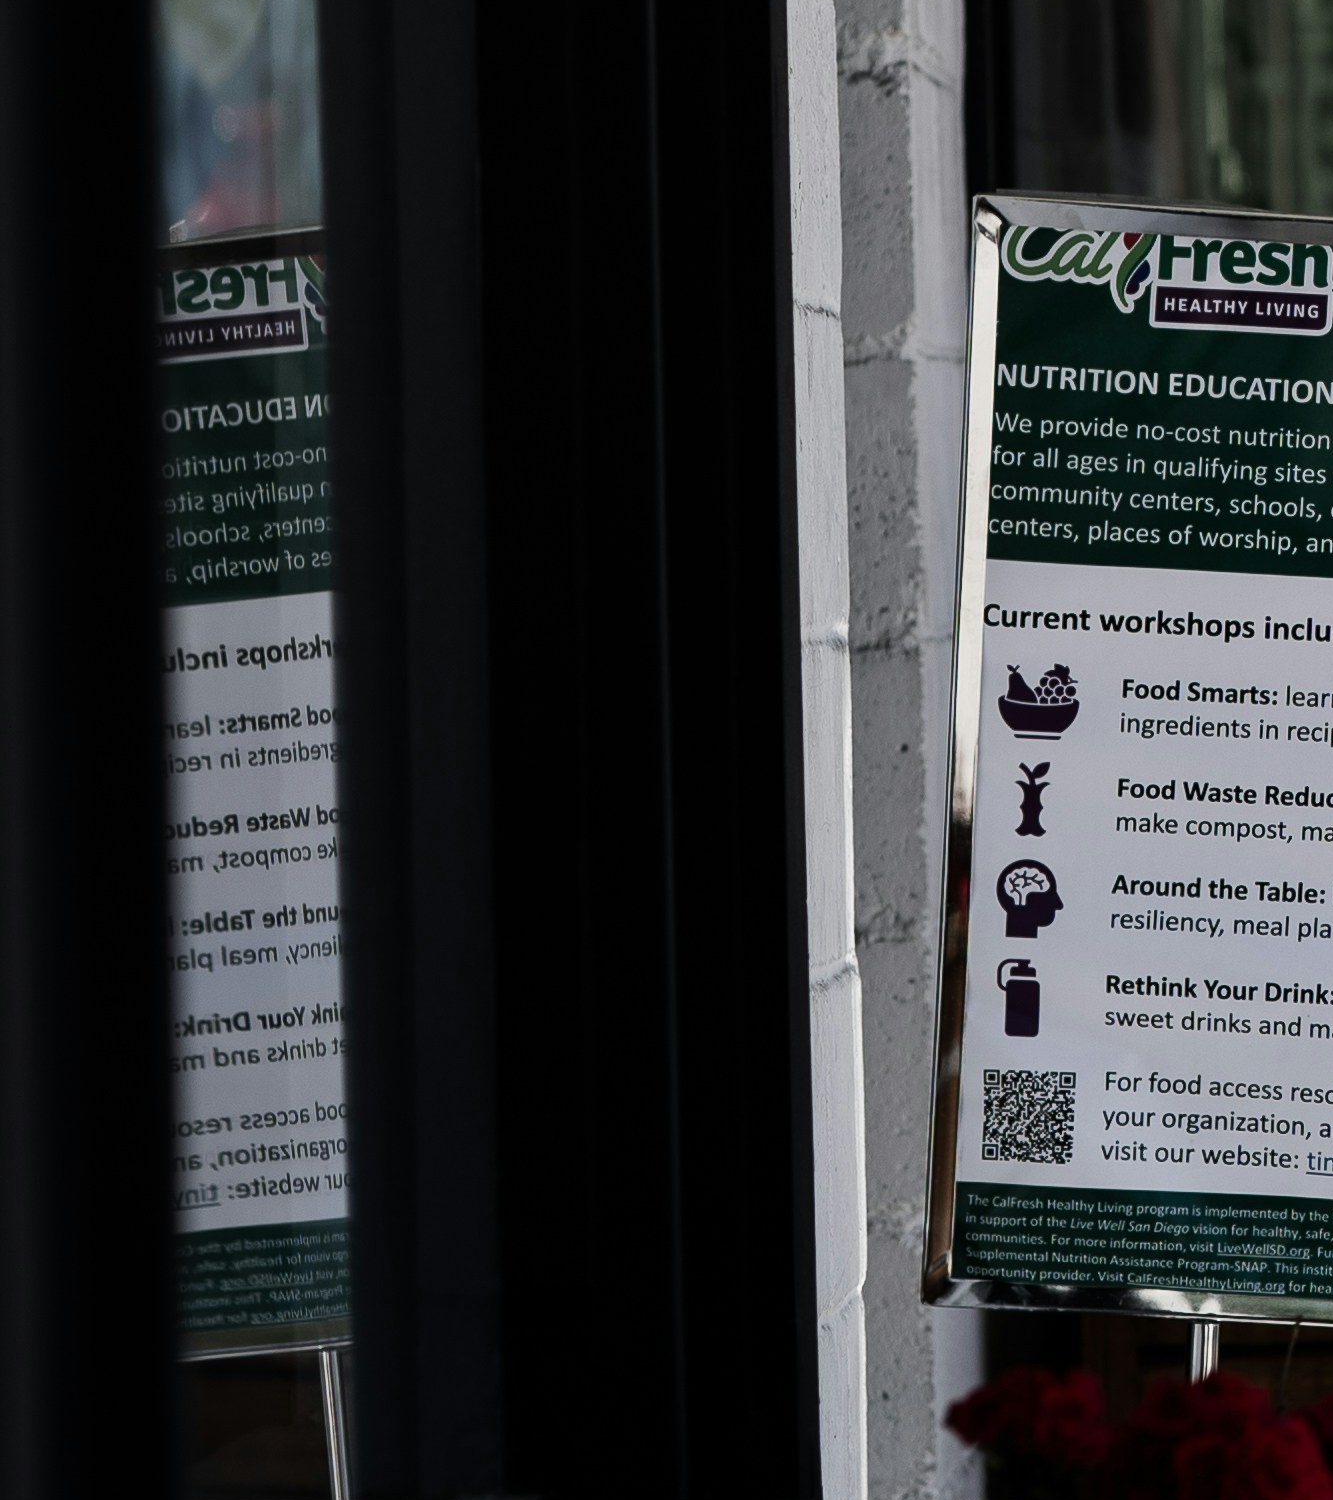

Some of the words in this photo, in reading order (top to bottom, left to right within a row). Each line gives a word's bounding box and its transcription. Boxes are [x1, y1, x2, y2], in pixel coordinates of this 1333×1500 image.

[1164, 297, 1248, 314] HEALTHY
[1256, 302, 1318, 318] LIVING
[996, 362, 1158, 395] NUTRITION
[995, 412, 1032, 433] We
[1041, 417, 1128, 438] provide
[1137, 425, 1221, 444] no-cost
[1229, 428, 1330, 450] nutrition
[991, 445, 1026, 466] for
[1033, 448, 1058, 468] all
[1067, 455, 1118, 475] ages
[1127, 453, 1145, 474] in
[1154, 457, 1267, 486] qualifying
[1275, 462, 1326, 484] sites
[990, 482, 1123, 511] community
[1130, 492, 1220, 516] centers,
[1230, 494, 1322, 522] schools,
[988, 516, 1078, 543] centers,
[1088, 520, 1160, 544] places
[1169, 525, 1193, 545] of
[1199, 529, 1297, 555] worship,
[984, 604, 1091, 631] Current
[1100, 610, 1255, 643] workshops
[1122, 679, 1180, 701] Food
[1187, 682, 1278, 705] Smarts:
[1118, 778, 1176, 800] Food
[1183, 781, 1257, 804] Waste
[1112, 875, 1201, 898] Around
[1208, 878, 1248, 900] the
[1255, 881, 1325, 904] Table:
[1111, 910, 1224, 938] resiliency,
[1234, 916, 1289, 936] meal
[1106, 975, 1197, 998] Rethink
[1204, 980, 1258, 1001] Your
[1106, 1071, 1142, 1092] For
[1148, 1072, 1201, 1095] food
[1209, 1081, 1282, 1100] access
[1103, 1110, 1156, 1130] your
[1162, 1111, 1311, 1140] organization,
[1101, 1143, 1147, 1162] visit
[1155, 1147, 1195, 1163] our
[1202, 1145, 1299, 1169] website:
[968, 1194, 989, 1206] The
[992, 1196, 1043, 1209] CalFresh
[1047, 1199, 1094, 1214] Healthy
[1098, 1202, 1133, 1216] Living
[1137, 1206, 1189, 1217] program
[1192, 1208, 1201, 1216] is
[1205, 1206, 1287, 1220] implemented
[1291, 1210, 1306, 1222] by
[1309, 1211, 1329, 1222] the
